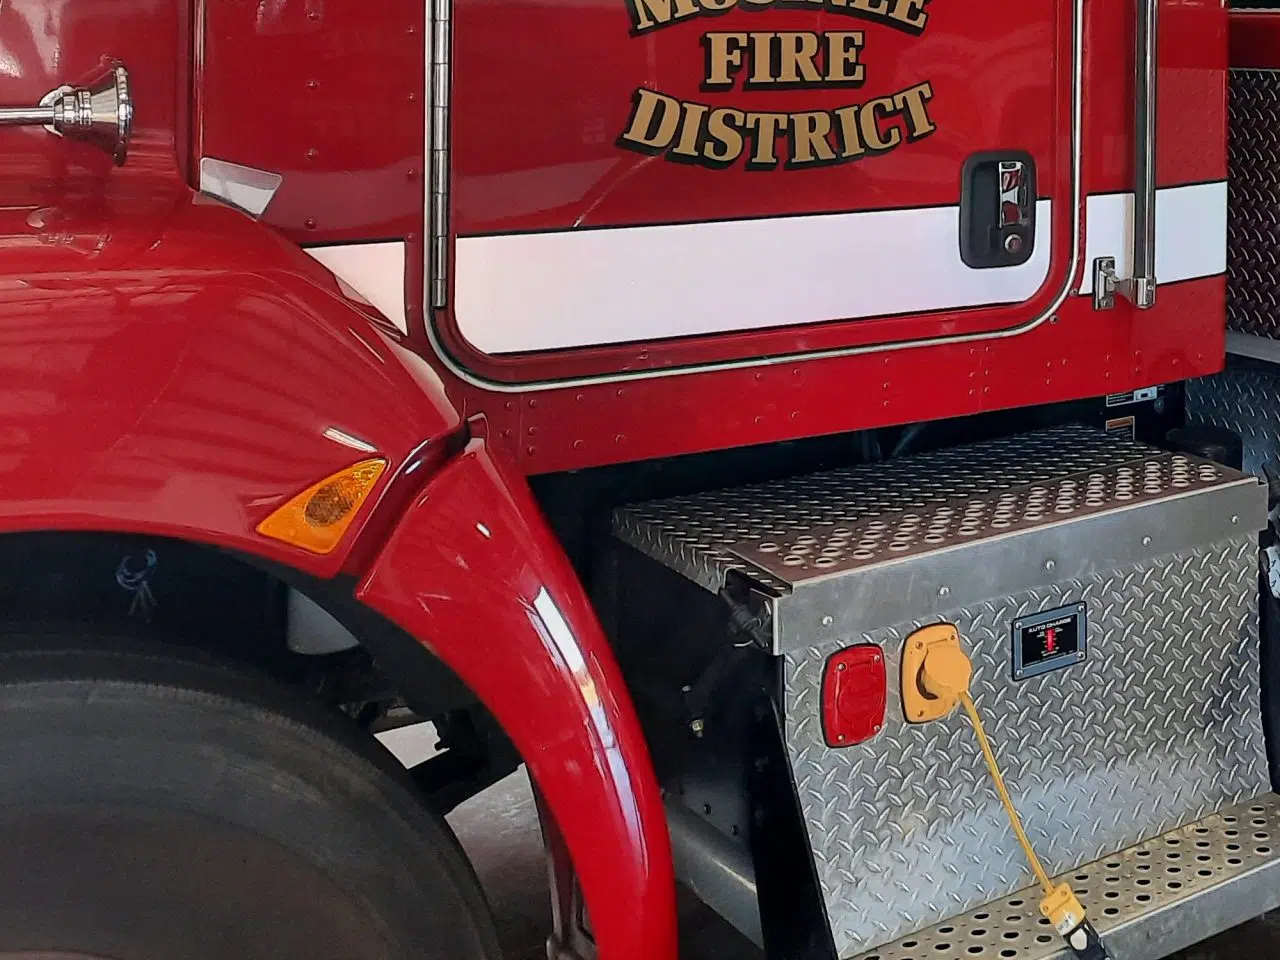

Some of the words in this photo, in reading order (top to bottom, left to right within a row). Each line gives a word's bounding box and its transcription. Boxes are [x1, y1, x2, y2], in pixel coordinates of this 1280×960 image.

[701, 31, 866, 90] FIRE
[615, 82, 937, 170] DISTRICT
[1028, 625, 1046, 634] AUTO
[1046, 617, 1072, 629] CHARGE
